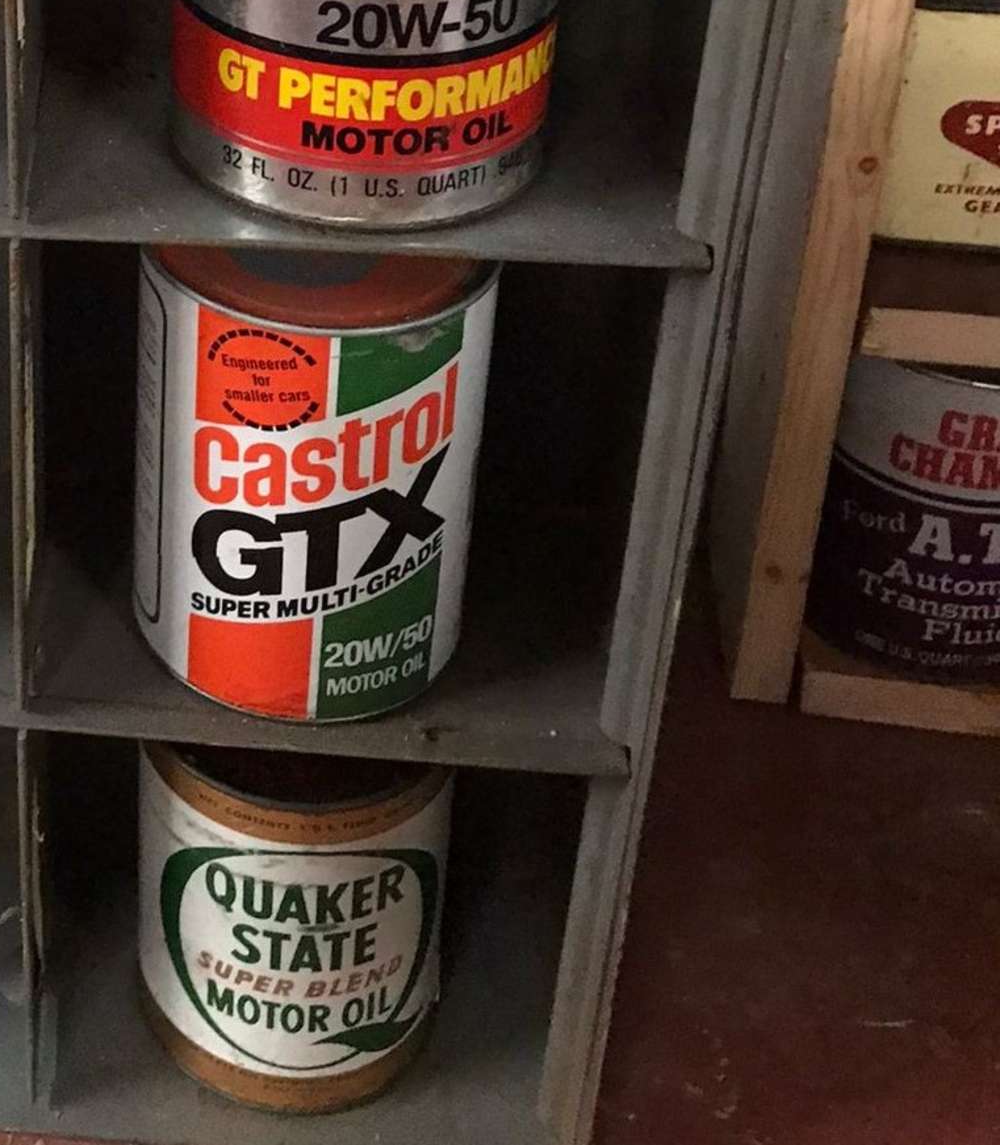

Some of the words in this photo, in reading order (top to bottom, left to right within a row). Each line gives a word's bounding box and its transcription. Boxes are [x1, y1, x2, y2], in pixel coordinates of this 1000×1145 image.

[217, 47, 266, 99] GT
[300, 120, 449, 156] MOTOR
[462, 110, 512, 147] OIL
[221, 144, 243, 171] 32
[251, 156, 275, 182] FL.
[287, 167, 318, 192] OZ.
[364, 177, 405, 198] U.S.
[416, 165, 486, 197] QUART)
[221, 353, 298, 373] Engineered
[252, 373, 271, 387] for
[224, 387, 275, 403] smaller
[279, 389, 311, 403] cars
[193, 361, 459, 507] Castrol
[191, 441, 451, 596] GTX
[191, 591, 271, 619] SUPER
[276, 529, 444, 618] MULTI-GRADE
[324, 614, 433, 668] 20W/50
[327, 668, 397, 696] MOTOR
[402, 657, 424, 678] OIL
[205, 862, 406, 924] QUAKER
[231, 923, 378, 973] STATE
[196, 950, 295, 997] SUPER
[304, 955, 402, 999] BLEND
[207, 978, 330, 1034] MOTOR
[342, 987, 392, 1028] OIL
